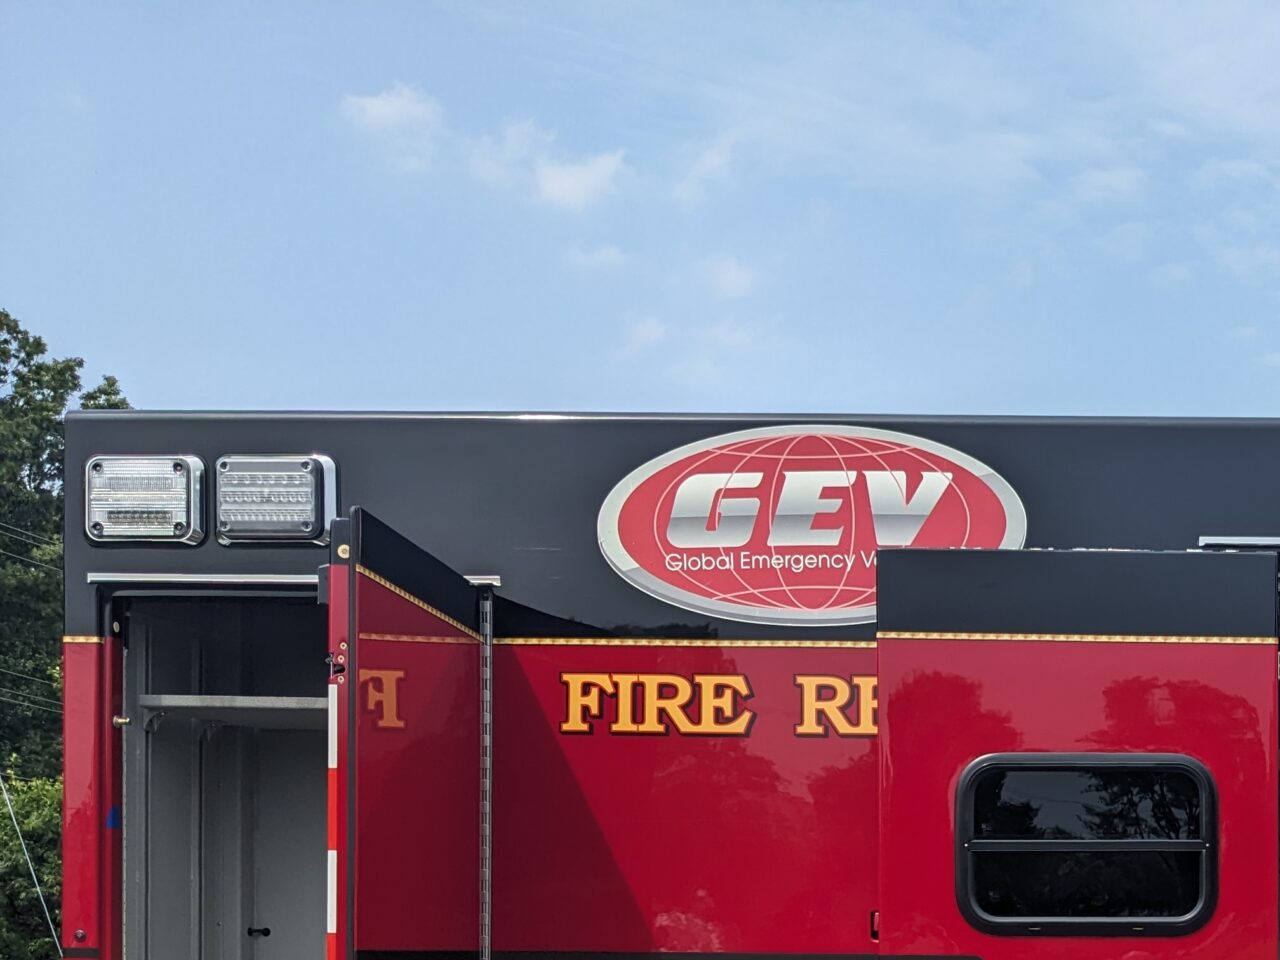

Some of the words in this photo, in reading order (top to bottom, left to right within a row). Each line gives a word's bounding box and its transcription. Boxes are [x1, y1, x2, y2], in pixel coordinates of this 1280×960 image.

[666, 471, 953, 548] GEV
[665, 552, 734, 571] Global
[740, 551, 856, 573] Emergency
[560, 672, 756, 736] FIRE
